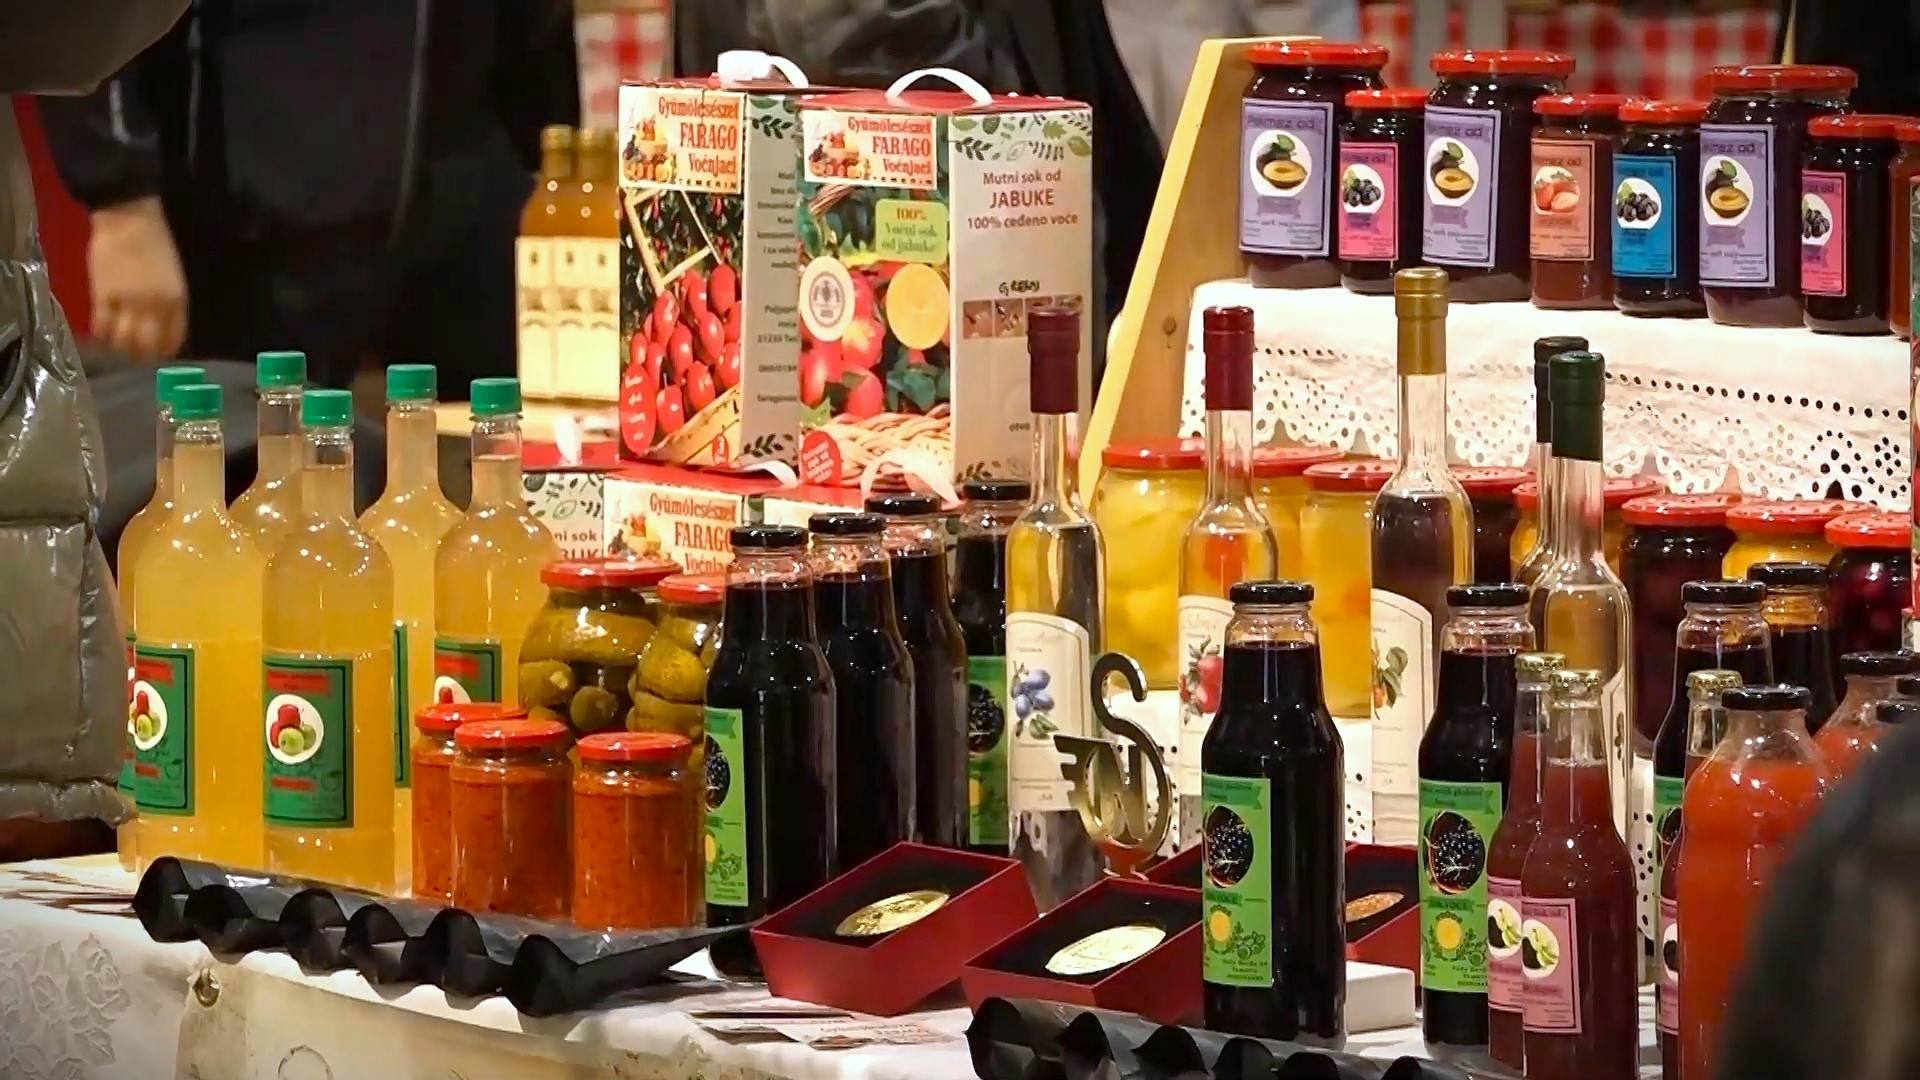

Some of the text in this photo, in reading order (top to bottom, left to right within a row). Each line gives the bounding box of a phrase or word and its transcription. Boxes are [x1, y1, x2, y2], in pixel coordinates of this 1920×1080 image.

[680, 122, 737, 151] FARAGO
[872, 135, 932, 157] FARAGO
[983, 168, 1061, 185] Mutni sok od
[989, 188, 1055, 209] JABUKE
[967, 215, 1001, 230] 100%
[571, 528, 597, 542] sok
